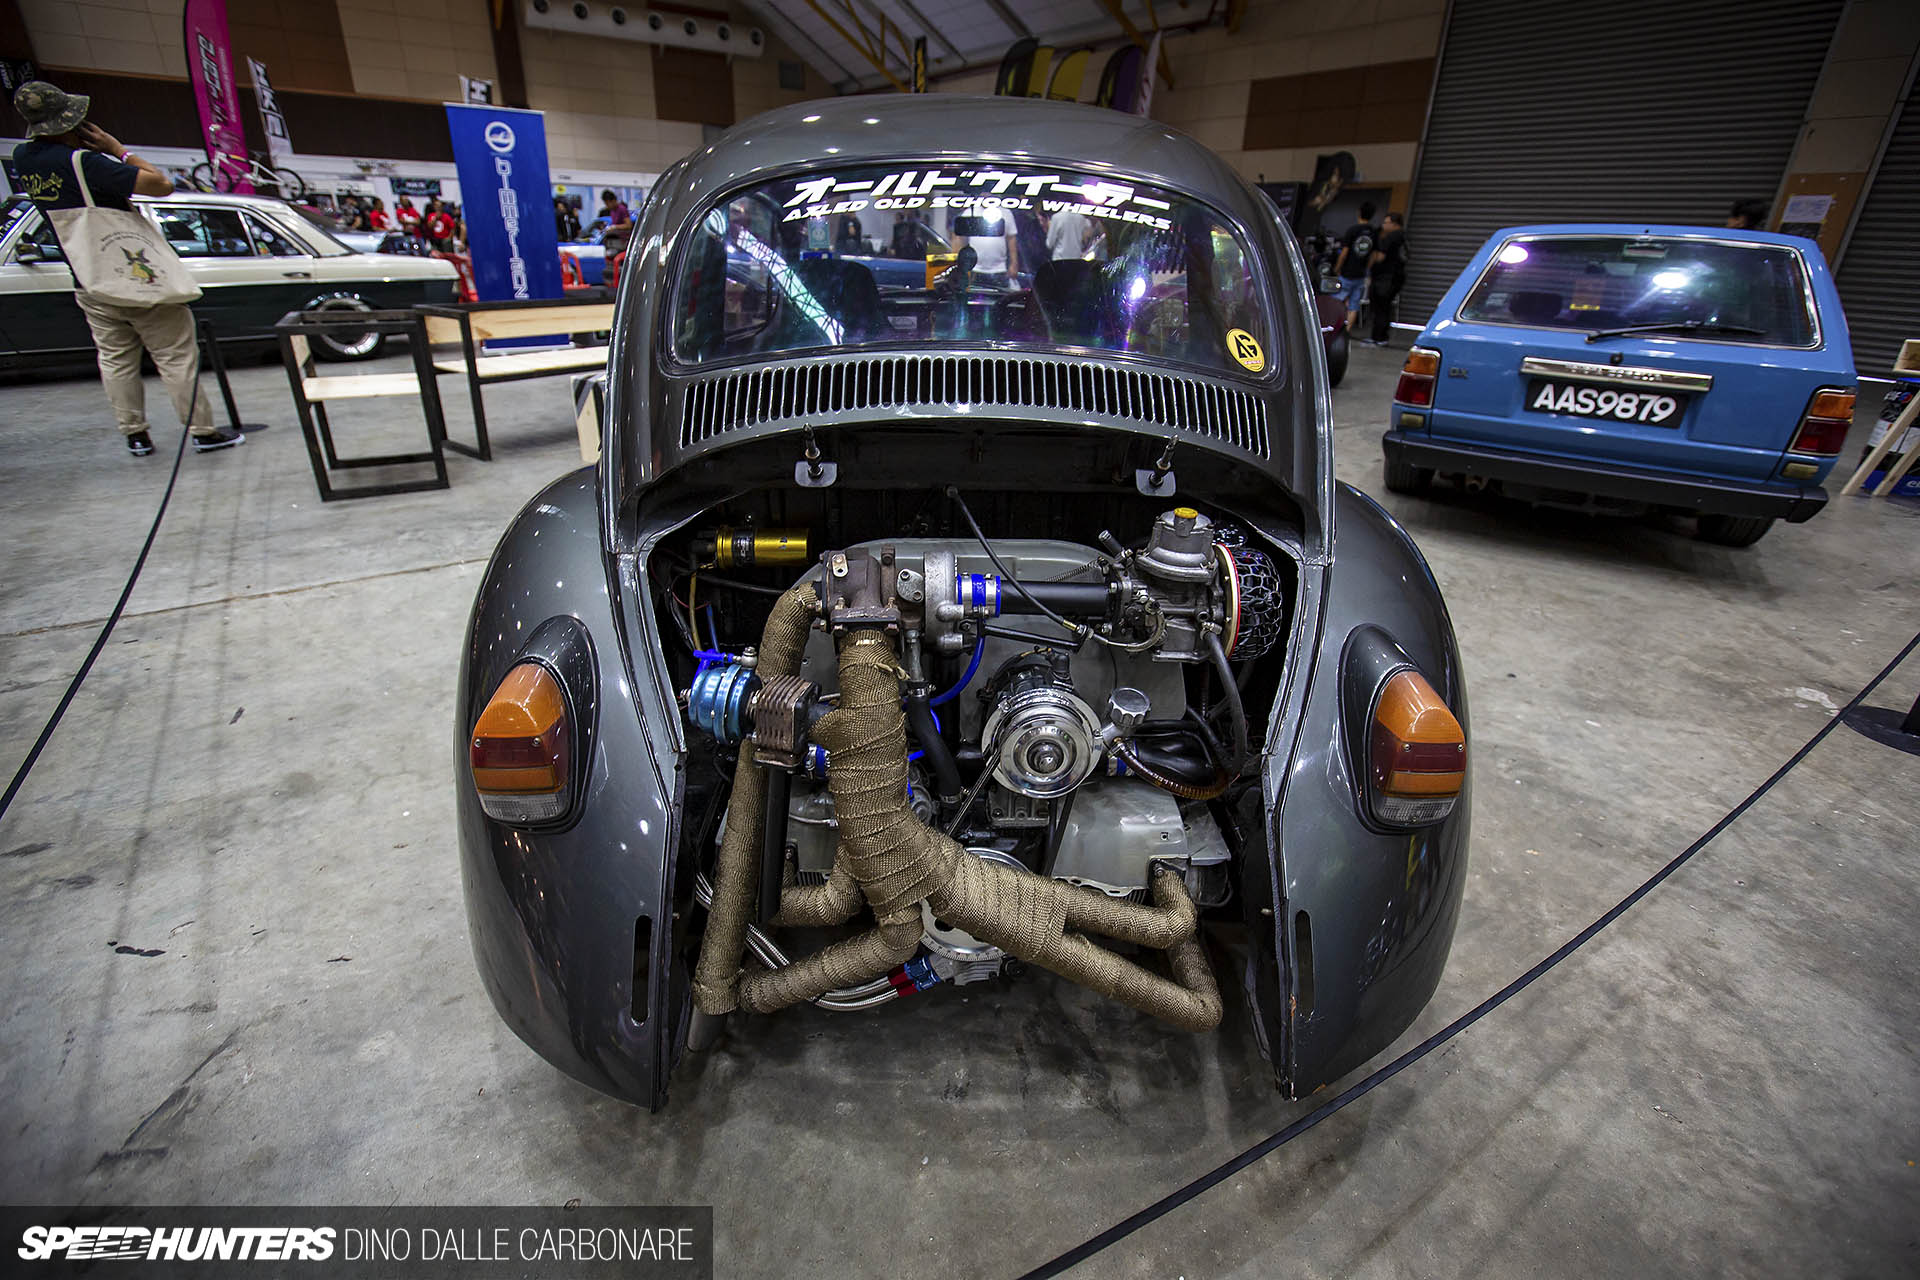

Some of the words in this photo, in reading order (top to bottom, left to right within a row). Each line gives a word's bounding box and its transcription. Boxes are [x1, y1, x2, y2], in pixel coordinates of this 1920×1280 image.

[783, 200, 869, 222] AXLED
[874, 197, 926, 210] OLD
[930, 197, 1033, 210] SCHOOL
[1042, 200, 1172, 230] WHEELERS
[1533, 384, 1677, 423] AAS9879
